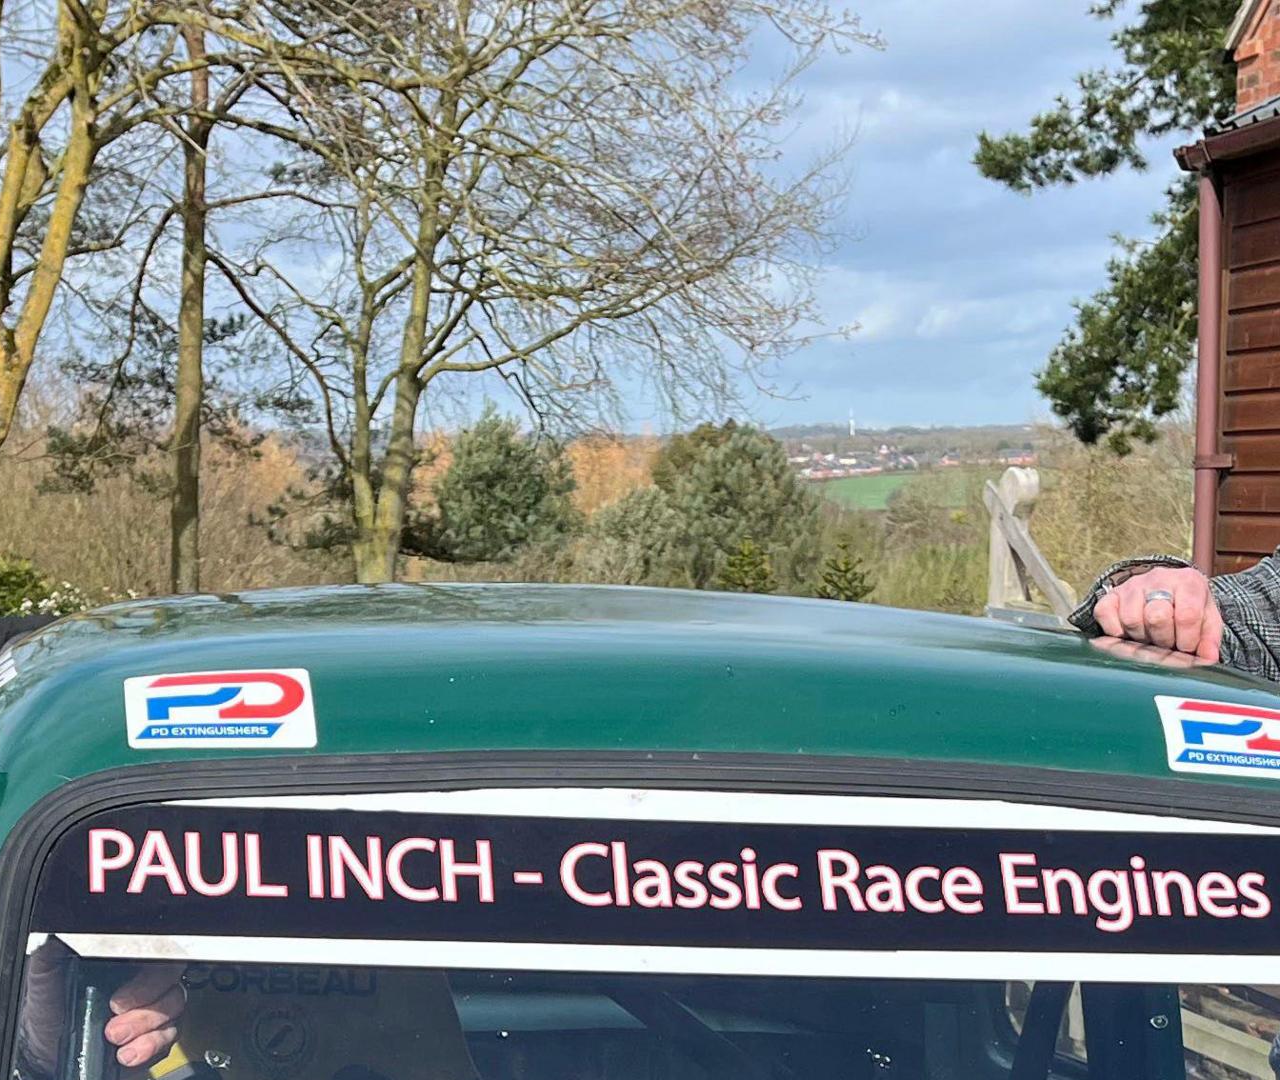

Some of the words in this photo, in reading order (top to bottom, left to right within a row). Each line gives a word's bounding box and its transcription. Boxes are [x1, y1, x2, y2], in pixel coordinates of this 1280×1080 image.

[151, 728, 168, 736] PD
[172, 726, 269, 736] EXTINGUISHERS
[1188, 751, 1204, 761] PD
[88, 828, 288, 897] PAUL
[307, 833, 494, 902] INCH
[559, 841, 801, 910] Classic
[816, 848, 984, 914] Race
[998, 852, 1272, 932] Engines
[183, 962, 378, 995] CORBEAU
